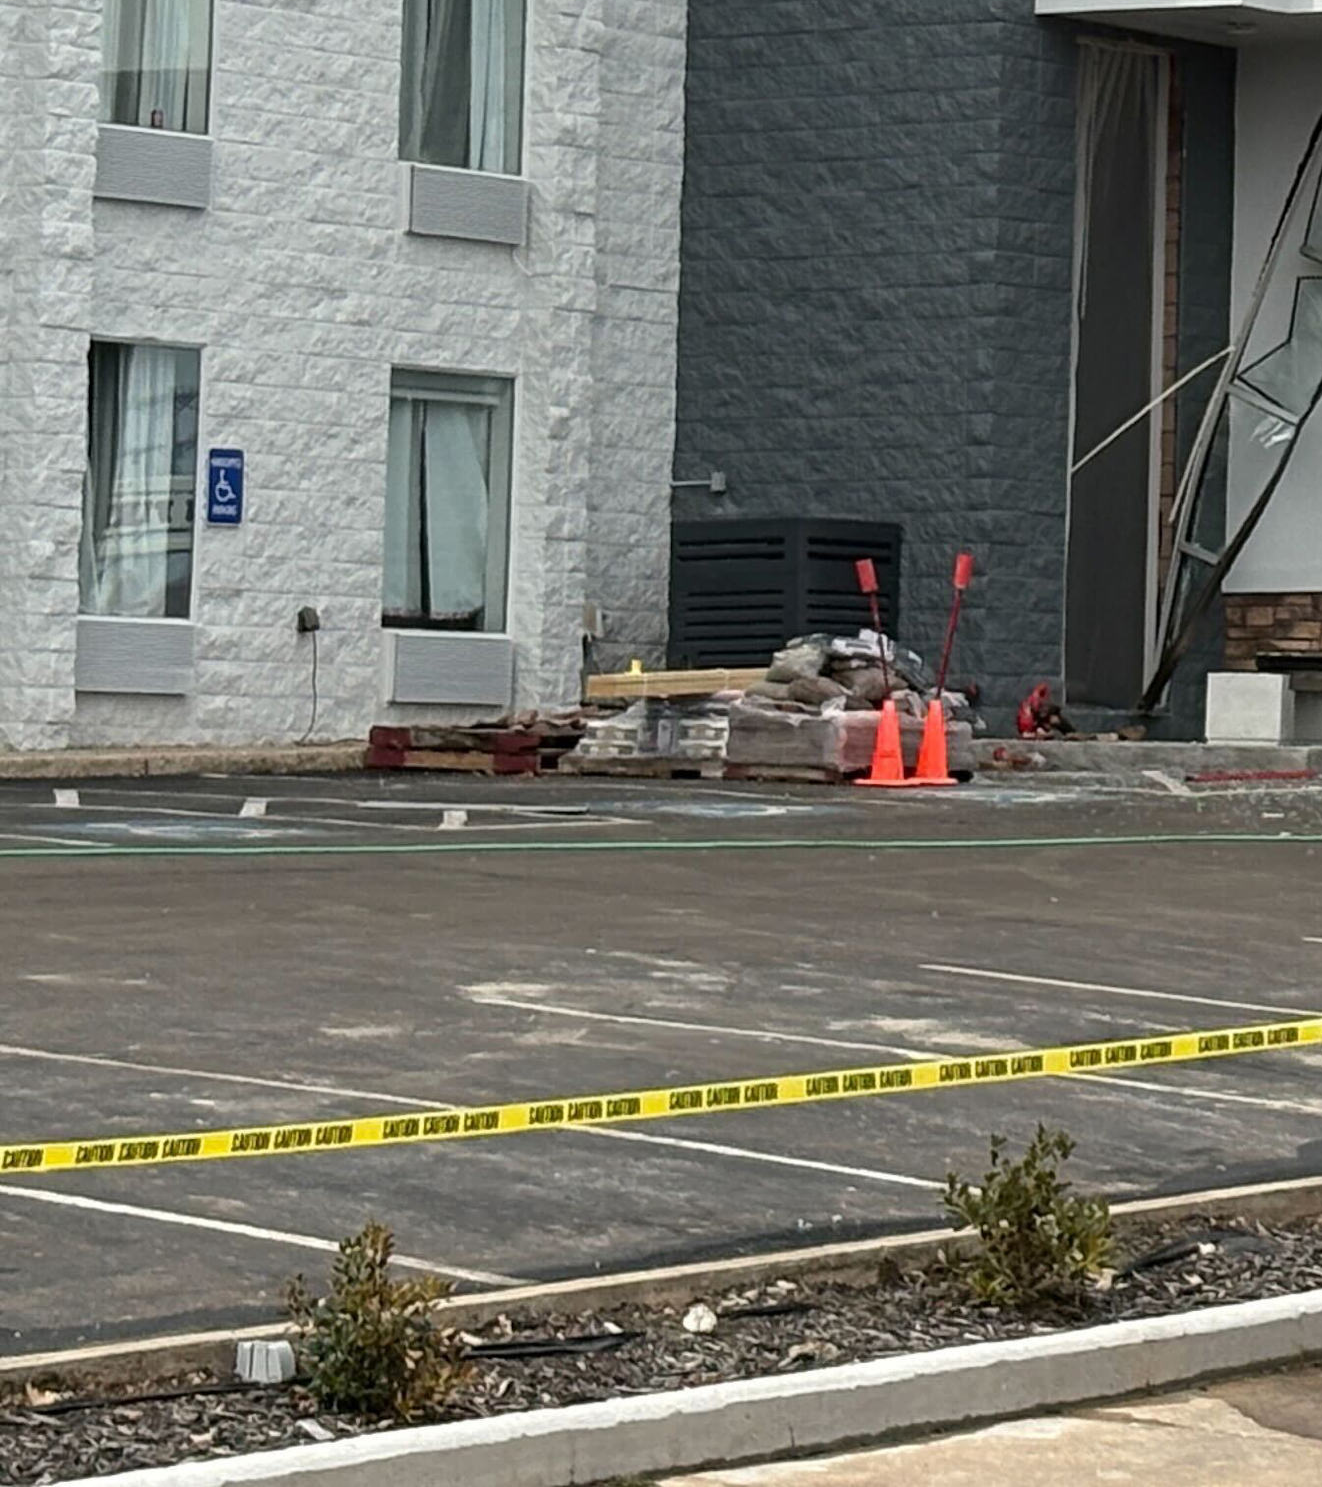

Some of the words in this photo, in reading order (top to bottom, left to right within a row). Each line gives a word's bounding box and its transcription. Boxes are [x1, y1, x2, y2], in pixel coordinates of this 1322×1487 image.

[3, 1149, 44, 1169] CAUTION
[76, 1144, 115, 1163] CAUTION
[118, 1140, 158, 1161] CAUTION
[162, 1138, 201, 1158] CAUTION
[231, 1132, 271, 1152] CAUTION
[274, 1127, 312, 1149] CAUTION
[316, 1124, 353, 1146] CAUTION
[383, 1119, 419, 1139] CAUTION
[423, 1115, 460, 1135] CAUTION
[464, 1111, 500, 1131] CAUTION
[528, 1104, 564, 1124] CAUTION
[567, 1100, 603, 1121] CAUTION
[606, 1097, 641, 1117] CAUTION
[669, 1090, 702, 1110] CAUTION
